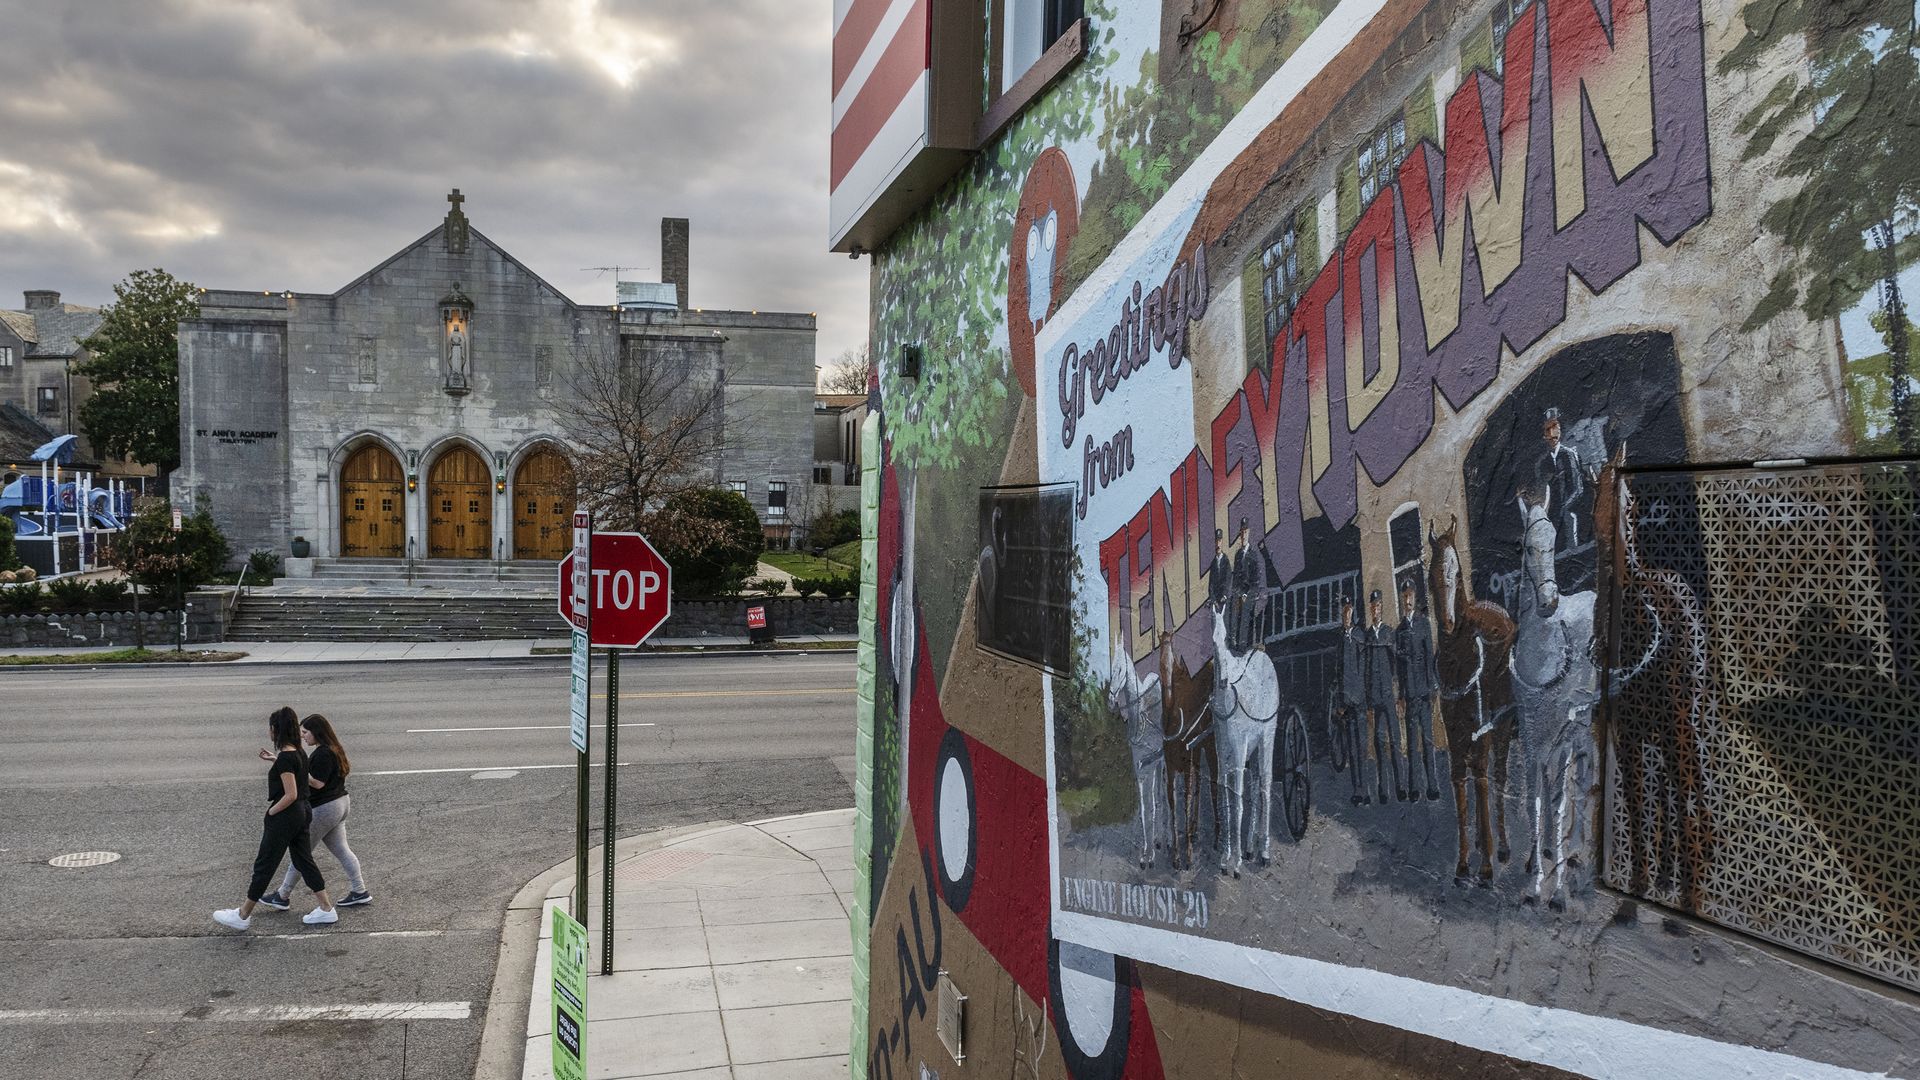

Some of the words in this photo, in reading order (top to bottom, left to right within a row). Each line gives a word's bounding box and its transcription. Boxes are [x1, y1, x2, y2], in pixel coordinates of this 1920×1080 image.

[1058, 241, 1209, 450] Greetings
[1100, 0, 1711, 682] TENLEYTOWN
[196, 429, 208, 437] ST.
[212, 429, 236, 437] ANN'S
[239, 430, 278, 438] ACADEMY
[1077, 424, 1134, 520] from
[568, 569, 661, 610] TOP
[1063, 876, 1118, 914] ENGINE
[1120, 883, 1180, 925] HOUSE
[1183, 890, 1208, 929] 20
